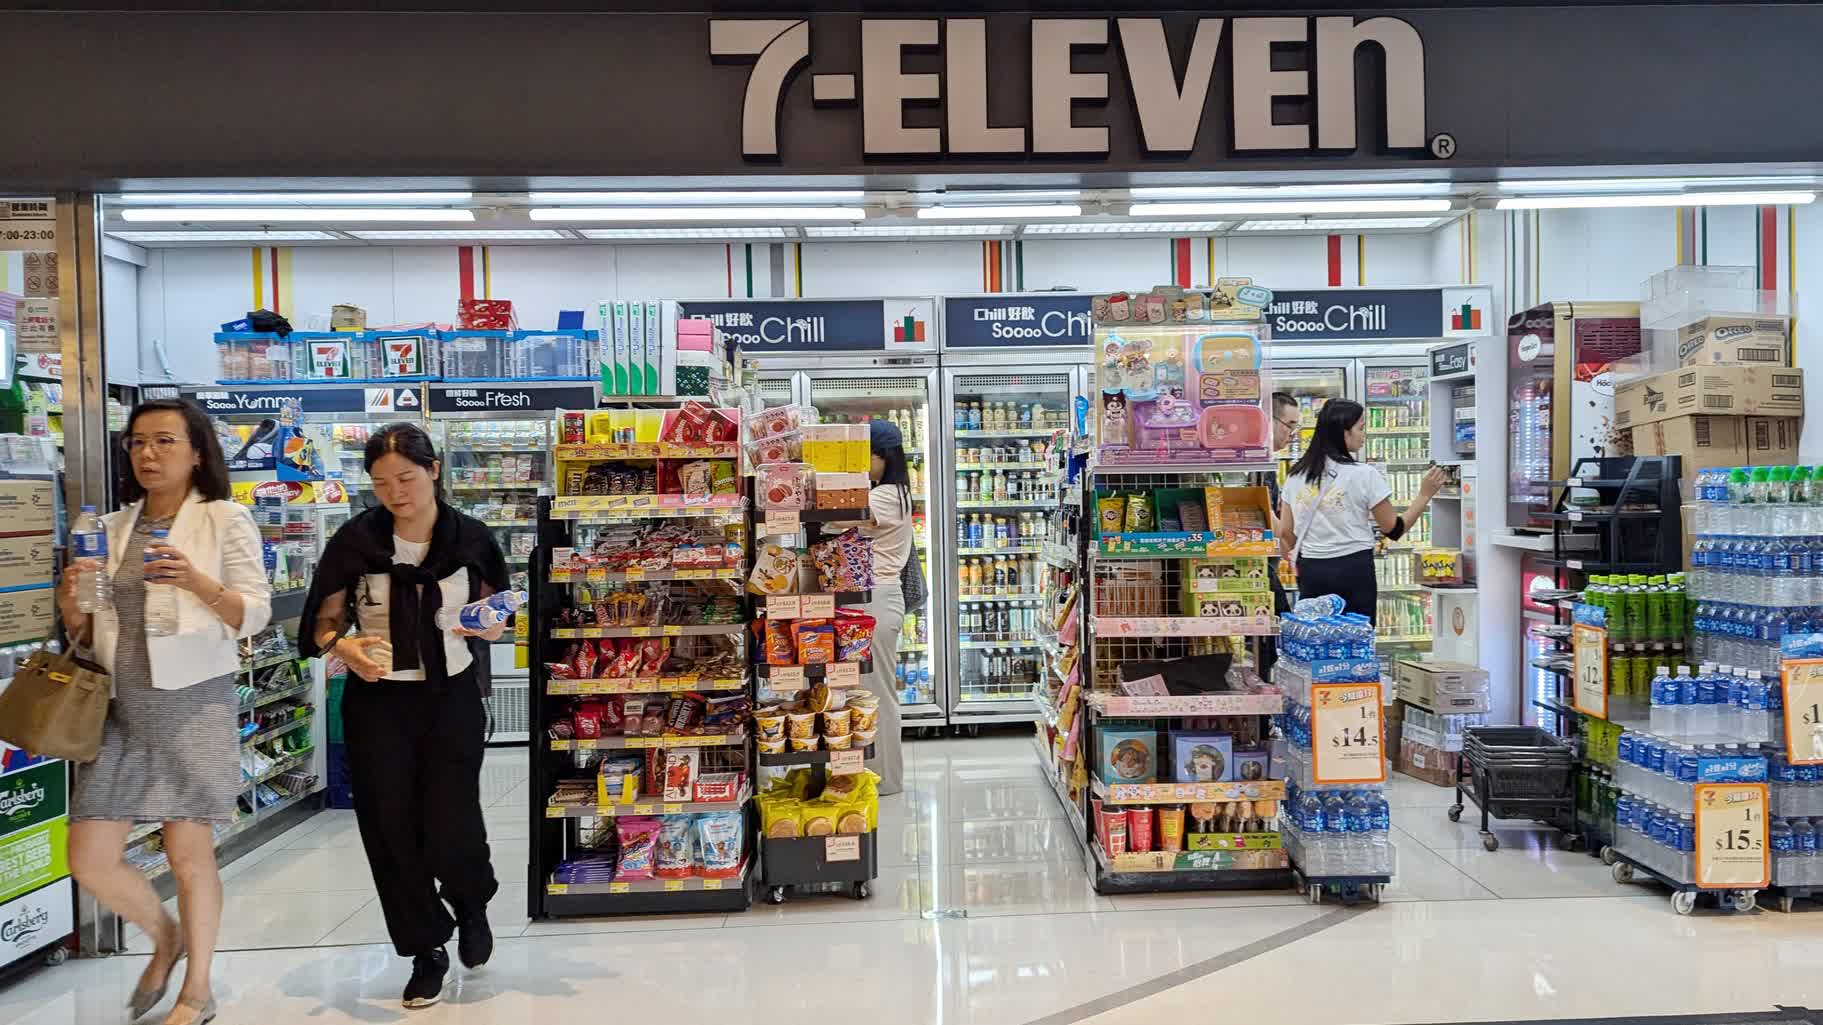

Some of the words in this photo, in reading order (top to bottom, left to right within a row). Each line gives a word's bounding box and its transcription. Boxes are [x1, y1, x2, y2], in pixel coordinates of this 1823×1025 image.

[992, 322, 1042, 338] Soooo
[1041, 310, 1092, 337] Chi
[1276, 316, 1325, 332] Soooo
[1324, 305, 1386, 331] Chill
[760, 317, 825, 344] Chill
[1714, 325, 1752, 340] OREO
[456, 397, 485, 407] Soooo
[486, 391, 530, 407] Fresh
[1360, 706, 1367, 718] 1
[1332, 726, 1378, 747] $14.5
[1744, 808, 1752, 821] 1
[1715, 829, 1762, 851] $15.5
[1, 909, 48, 942] Carlsberg
